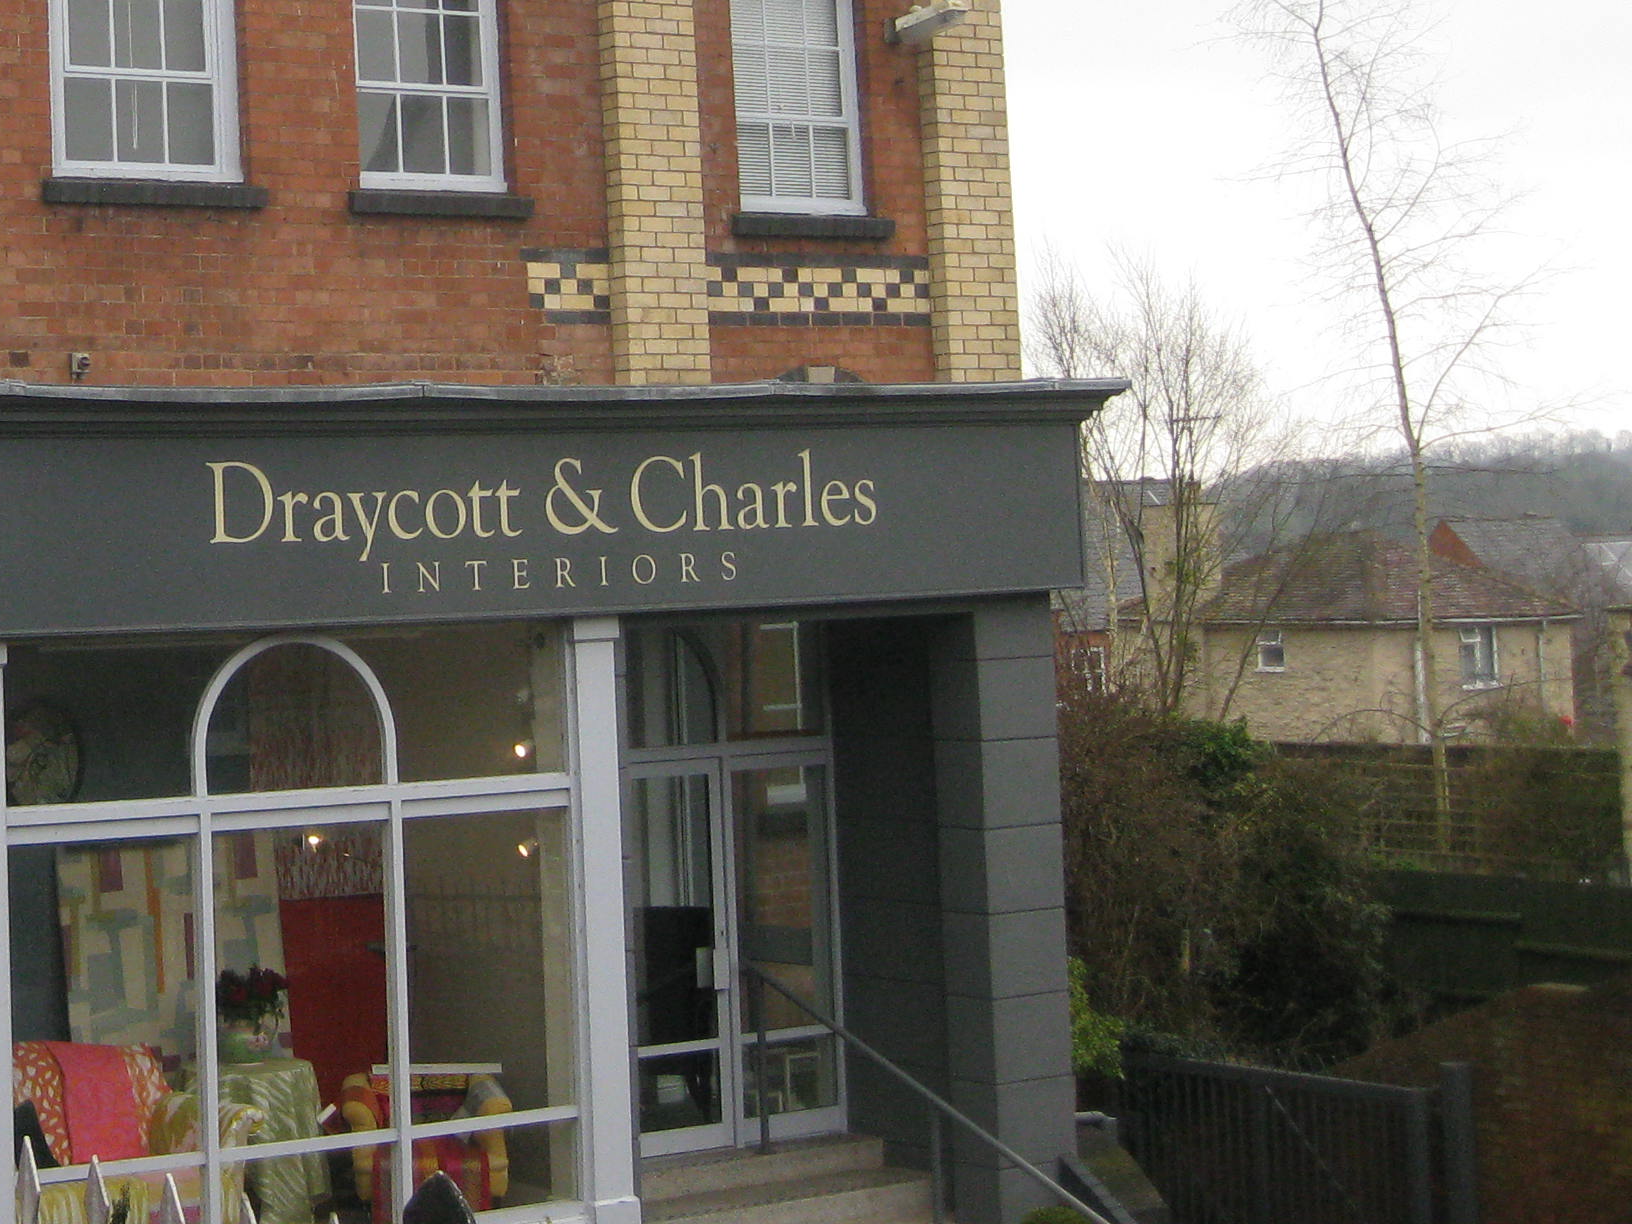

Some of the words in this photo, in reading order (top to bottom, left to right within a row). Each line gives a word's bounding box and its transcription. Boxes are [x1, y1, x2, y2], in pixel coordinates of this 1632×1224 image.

[206, 461, 523, 562] Draycott
[545, 457, 619, 535] &
[630, 449, 877, 533] Charles
[381, 551, 738, 594] INTERIORS
